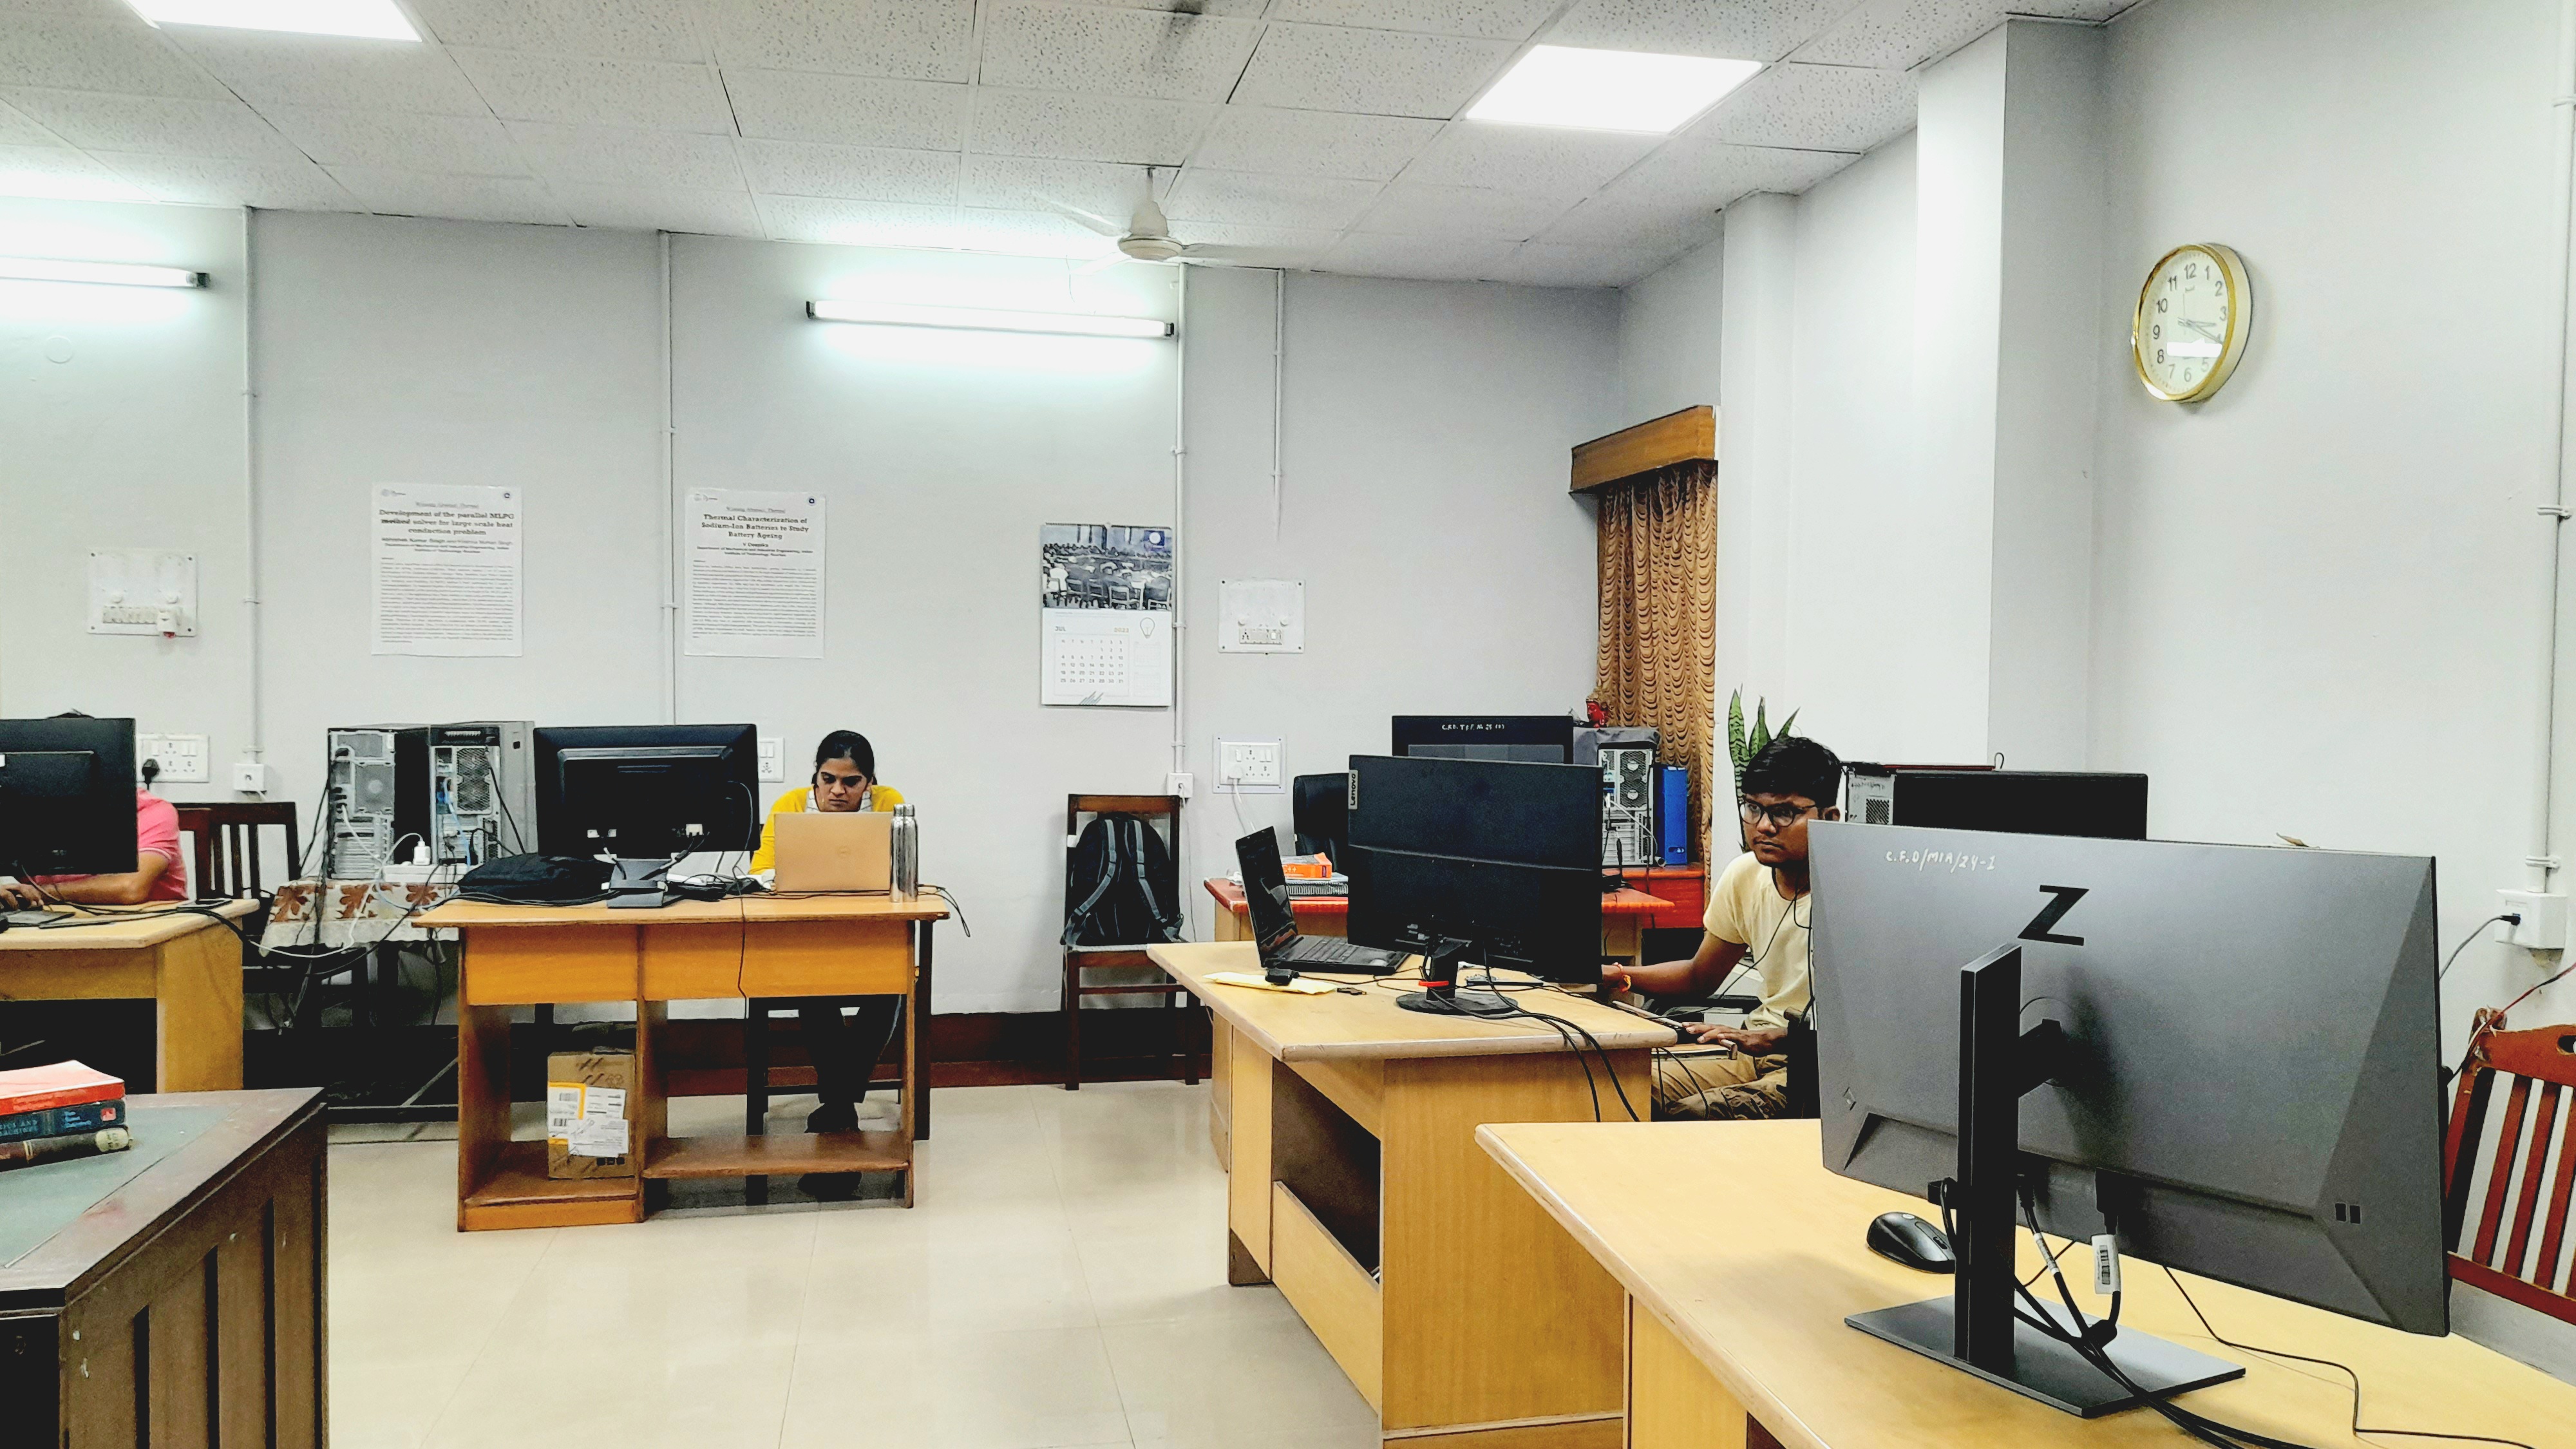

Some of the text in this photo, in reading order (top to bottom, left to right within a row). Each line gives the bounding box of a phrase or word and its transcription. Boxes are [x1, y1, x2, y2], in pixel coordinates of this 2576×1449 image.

[2184, 263, 2197, 279] 12
[2205, 266, 2210, 280] 1
[2168, 276, 2177, 290] 11
[2215, 280, 2223, 297] 2
[2156, 298, 2168, 314] 10
[2219, 307, 2227, 321] 3
[2153, 325, 2161, 340] 9
[2157, 349, 2164, 365] 8
[2168, 364, 2175, 379] 7
[2201, 357, 2209, 373] 5
[2184, 367, 2192, 382] 6
[379, 509, 431, 518] Development
[737, 515, 799, 524] Characterization
[2018, 885, 2089, 946] Z
